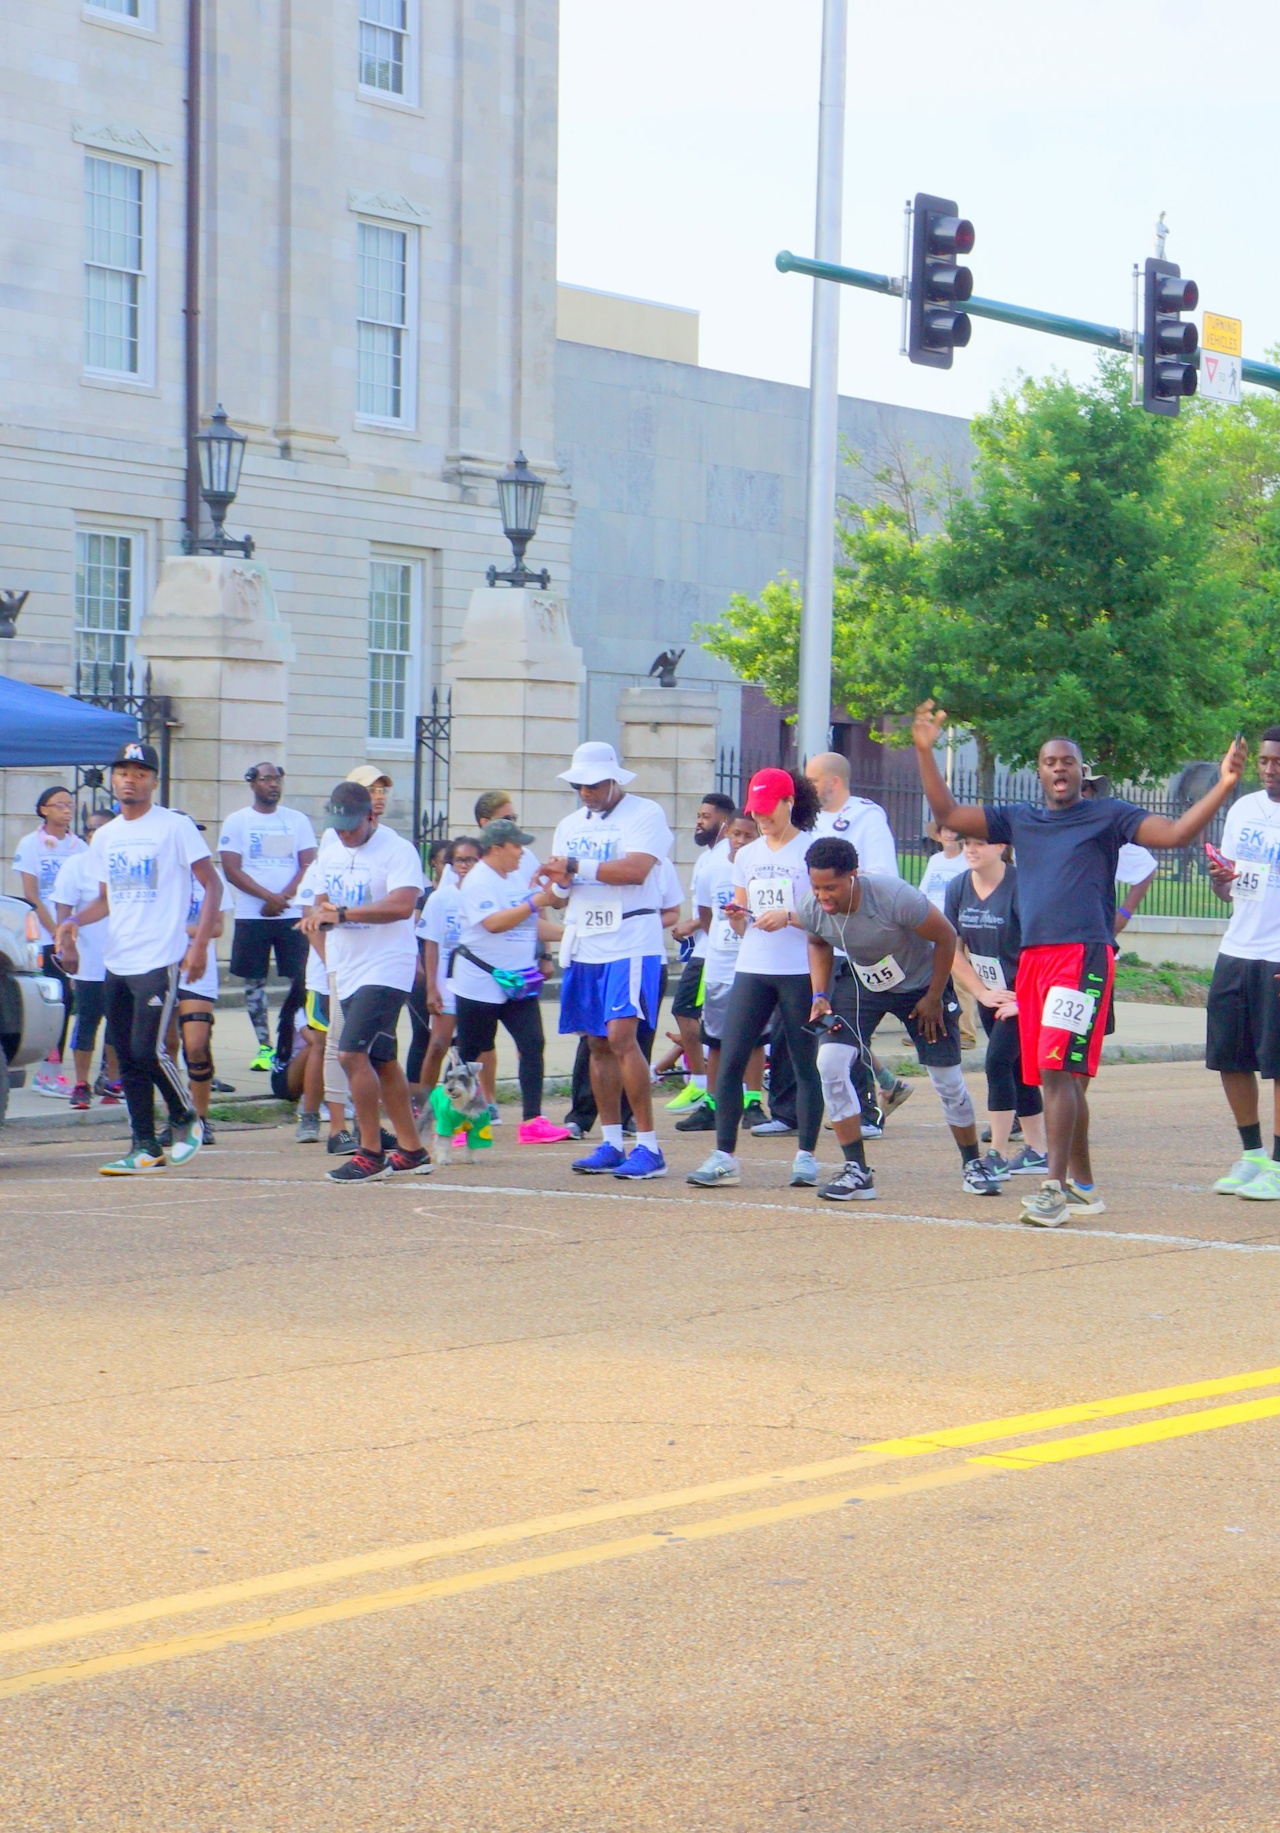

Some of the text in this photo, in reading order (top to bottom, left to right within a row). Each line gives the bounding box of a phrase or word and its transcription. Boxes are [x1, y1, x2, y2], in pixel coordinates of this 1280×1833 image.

[1206, 315, 1237, 335] TURNING
[1206, 333, 1238, 351] VEHICLES
[568, 836, 591, 850] 5K
[1239, 827, 1264, 847] 5K
[109, 851, 127, 868] 5K
[325, 874, 343, 890] 5K
[757, 889, 785, 906] 234
[585, 910, 613, 926] 250
[723, 928, 743, 942] 24
[862, 966, 893, 985] 215
[976, 963, 997, 981] 269
[1052, 998, 1085, 1021] 232
